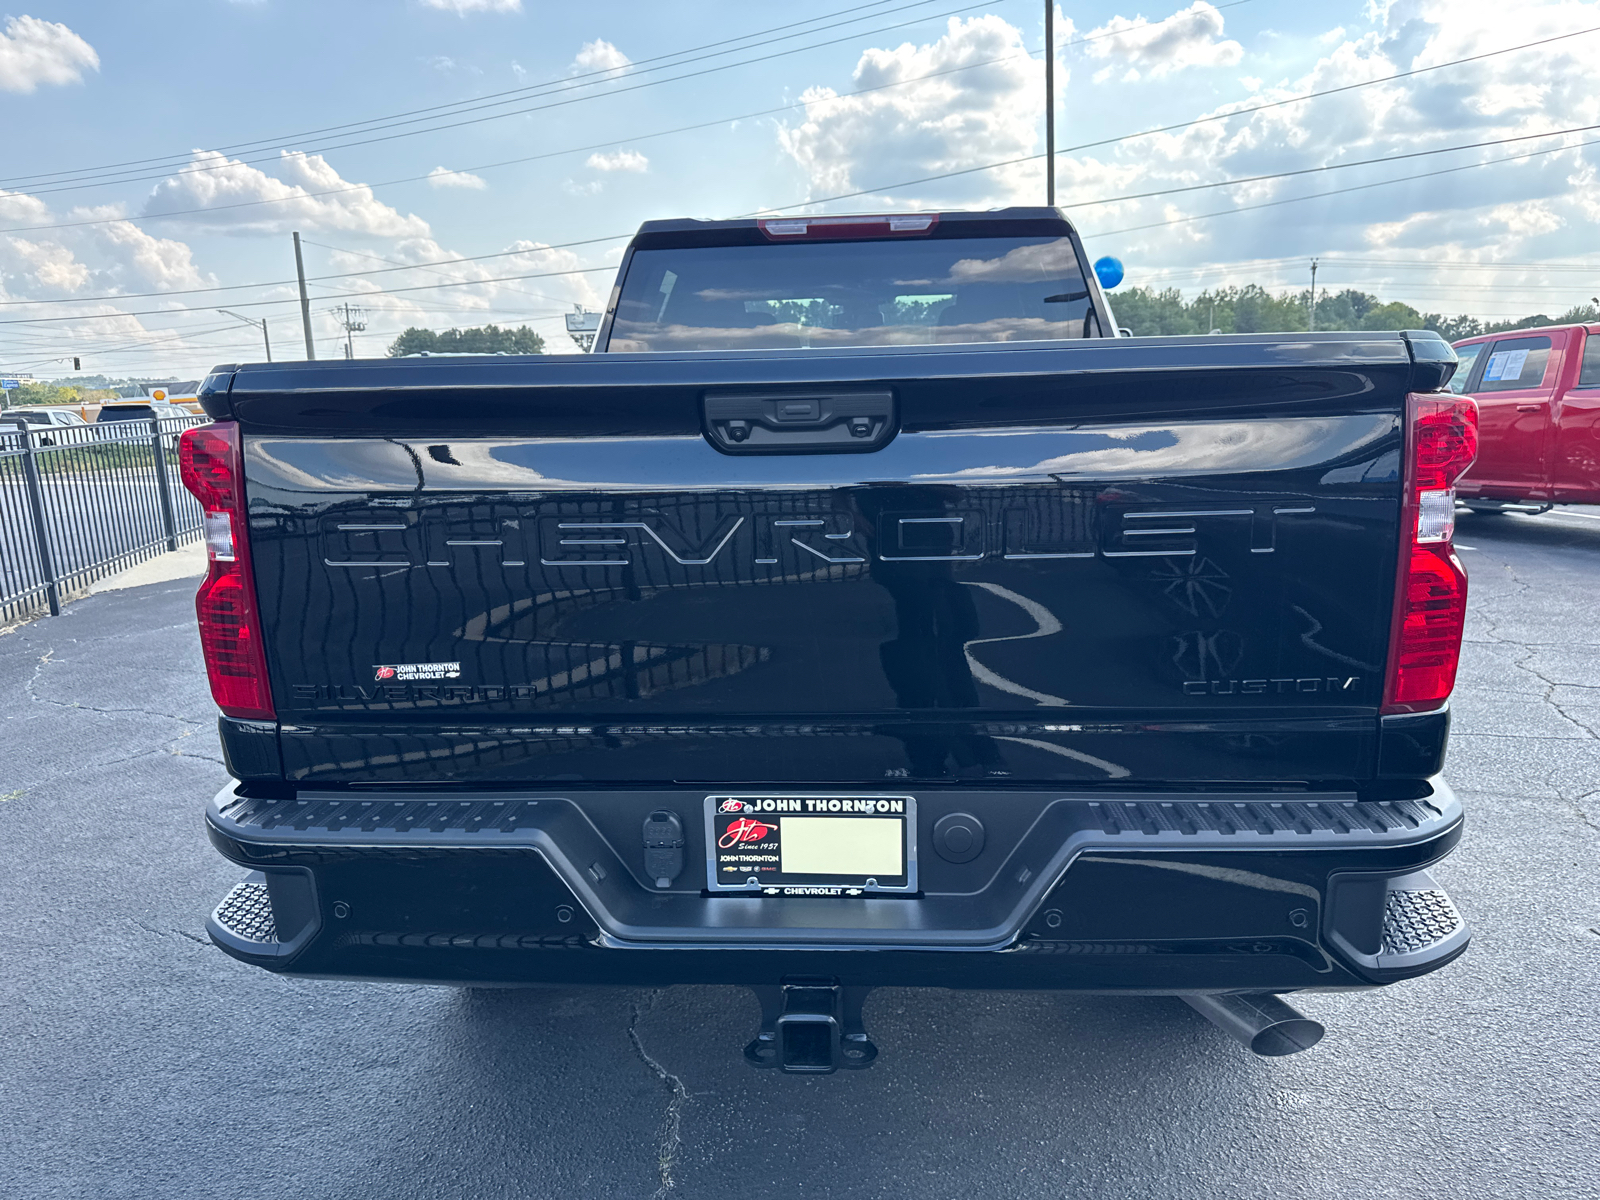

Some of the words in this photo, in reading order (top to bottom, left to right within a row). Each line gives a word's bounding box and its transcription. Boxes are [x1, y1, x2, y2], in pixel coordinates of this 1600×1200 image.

[321, 502, 1316, 566] CHEVROLET
[397, 665, 417, 673] JOHN
[417, 663, 460, 672] THORNTON
[397, 671, 445, 680] CHEVROLET
[293, 683, 538, 700] SILVERADO
[1182, 676, 1360, 696] CUSTOM
[754, 800, 801, 812] JOHN
